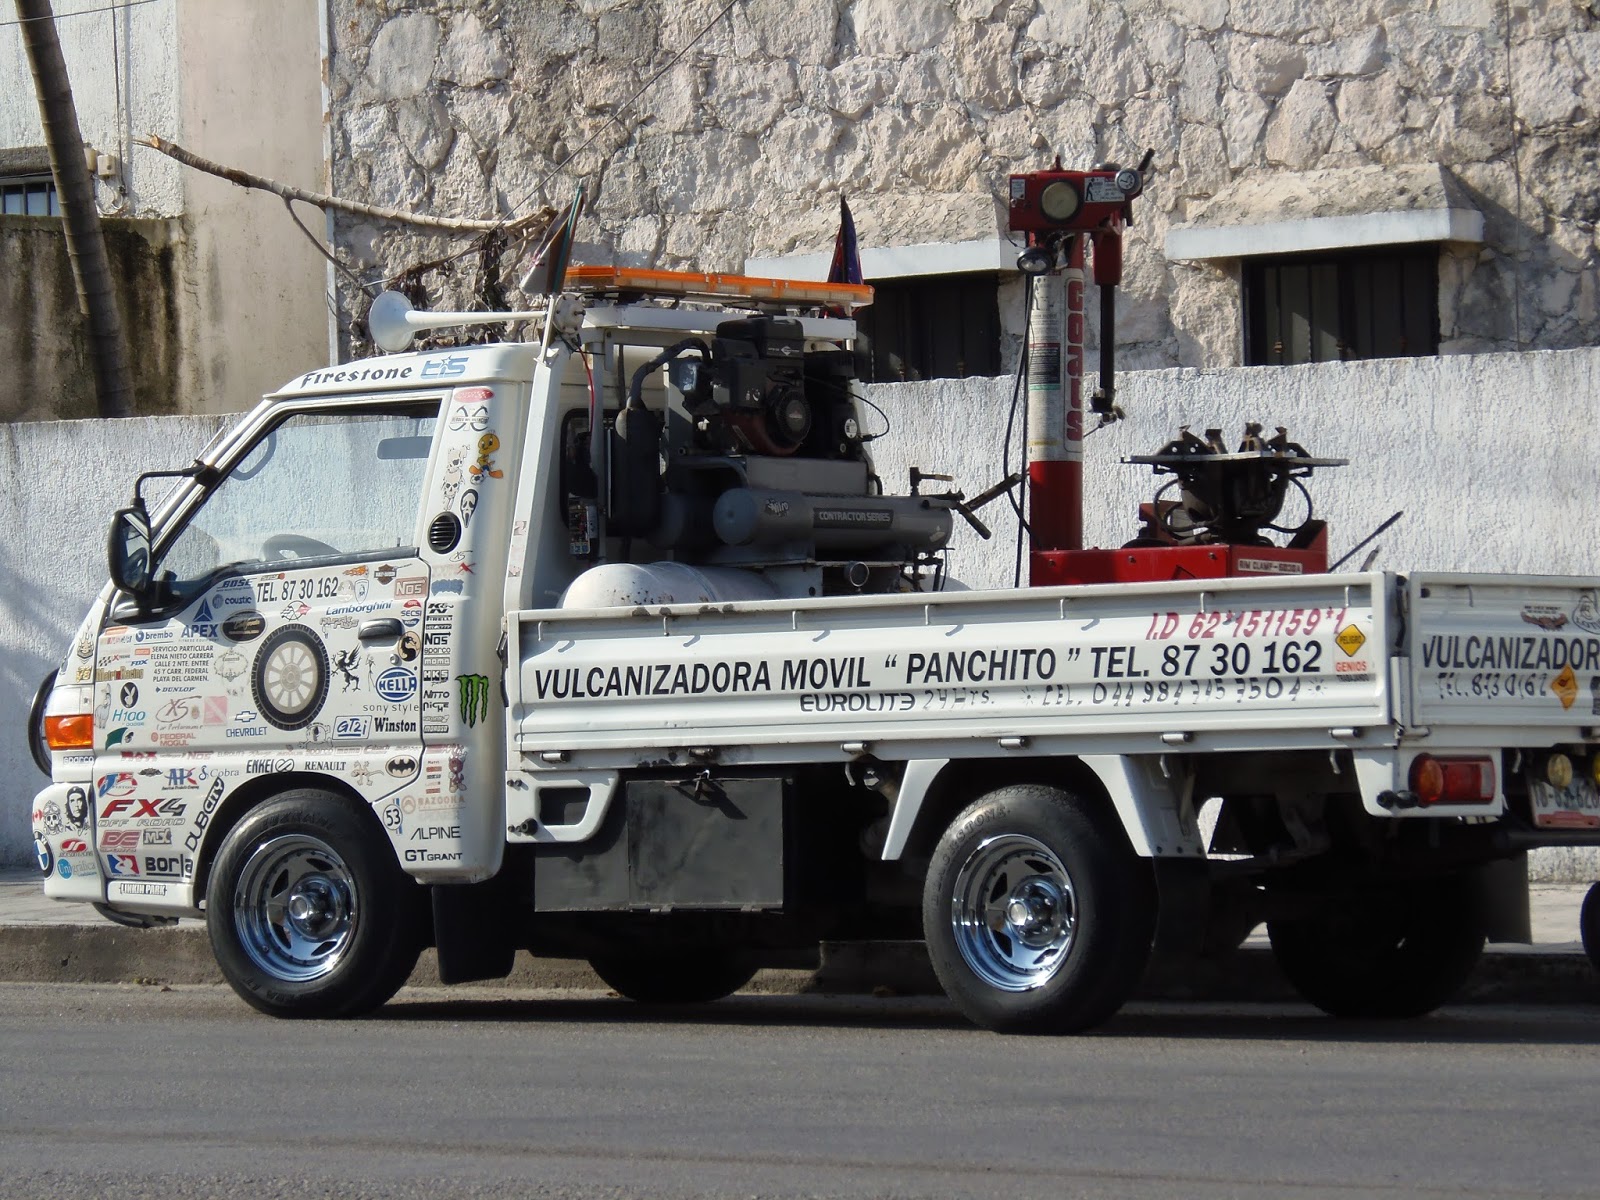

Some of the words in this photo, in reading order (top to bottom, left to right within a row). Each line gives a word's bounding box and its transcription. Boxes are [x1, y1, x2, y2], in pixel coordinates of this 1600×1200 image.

[300, 366, 412, 388] Firestone
[819, 511, 866, 521] CONTRACTOR
[867, 512, 890, 522] SERIES
[256, 582, 278, 602] TEL.
[281, 580, 296, 601] 87
[298, 578, 314, 599] 30
[316, 576, 339, 598] 162
[325, 600, 394, 616] Lamborghini
[145, 631, 174, 640] brembo
[181, 623, 219, 639] APEX
[424, 632, 450, 645] NOS
[535, 660, 771, 700] VULCANIZADORA
[781, 656, 871, 691] MOVIL
[906, 647, 1056, 684] PANCHITO
[1091, 646, 1150, 678] TEL.
[1161, 643, 1200, 676] 87
[1210, 642, 1250, 675] 30
[1261, 639, 1322, 674] 162
[1335, 661, 1367, 672] GENIOS
[423, 669, 449, 681] HKS
[378, 676, 418, 692] HELLA
[423, 690, 450, 699] NITTO
[112, 709, 146, 722] H100
[362, 704, 389, 716] sony
[391, 703, 420, 716] style
[374, 717, 417, 732] Winston
[226, 726, 267, 738] CHEVROLET
[246, 758, 275, 774] ENKEI
[304, 761, 347, 771] RENAULT
[209, 769, 240, 778] Cobra
[100, 797, 187, 819] FX4
[98, 819, 130, 828] OFF
[136, 818, 186, 828] ROAD
[386, 808, 401, 827] 53
[410, 826, 462, 841] ALPINE
